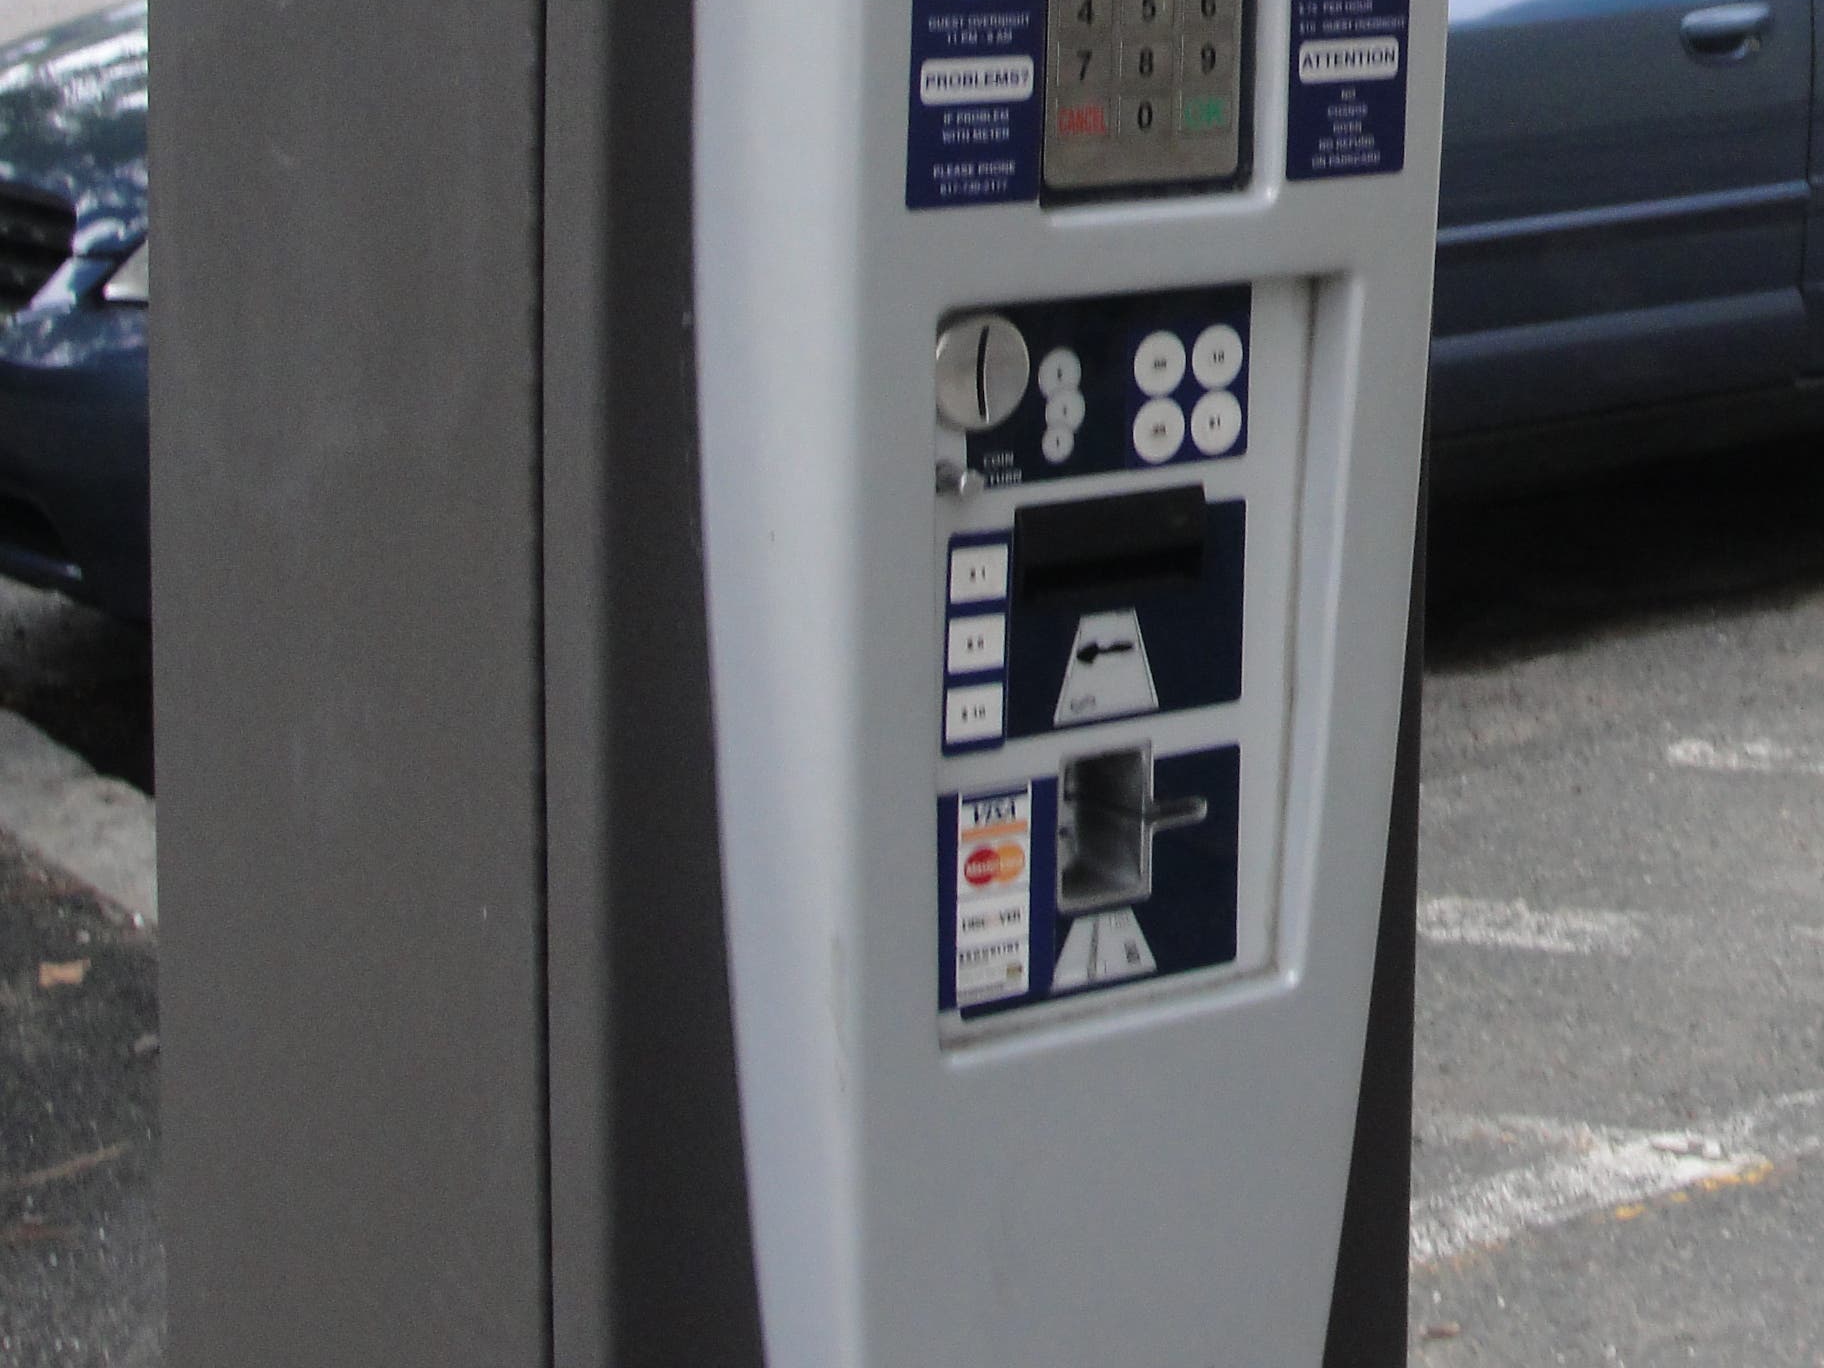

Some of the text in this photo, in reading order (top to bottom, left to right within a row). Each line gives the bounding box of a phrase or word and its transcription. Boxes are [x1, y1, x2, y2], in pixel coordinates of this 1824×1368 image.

[1076, 43, 1217, 81] 7 8 9
[1302, 46, 1396, 69] ATTENTION
[1137, 100, 1154, 131] 0
